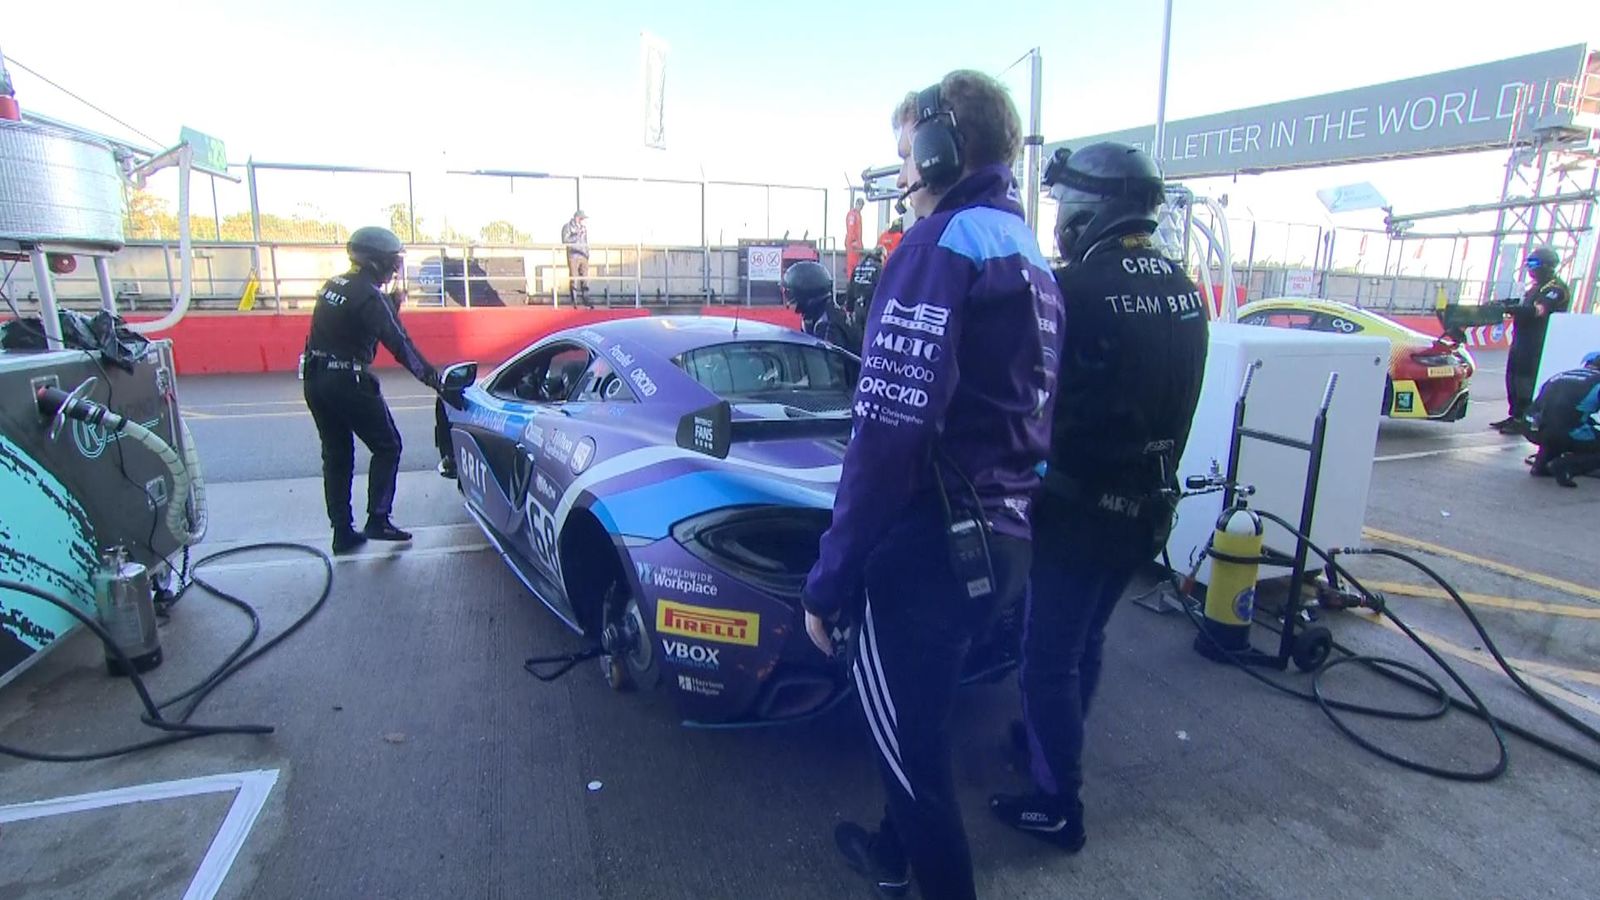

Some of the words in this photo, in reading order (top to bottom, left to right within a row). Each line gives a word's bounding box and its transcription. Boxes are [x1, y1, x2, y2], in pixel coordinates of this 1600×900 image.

[1172, 124, 1261, 161] LETTER
[1269, 119, 1298, 149] IN
[1304, 107, 1368, 144] THE
[1121, 257, 1173, 274] CREW
[1105, 294, 1161, 314] TEAM
[1166, 291, 1203, 313] BRIT
[864, 355, 935, 383] KENWOOD
[859, 376, 929, 408] ORCKID
[694, 424, 713, 441] FANS
[460, 446, 488, 495] BRIT
[653, 573, 718, 596] Workplace
[660, 566, 713, 583] WORLDWIDE
[664, 607, 748, 640] PIRELLI
[662, 639, 720, 665] VBOX
